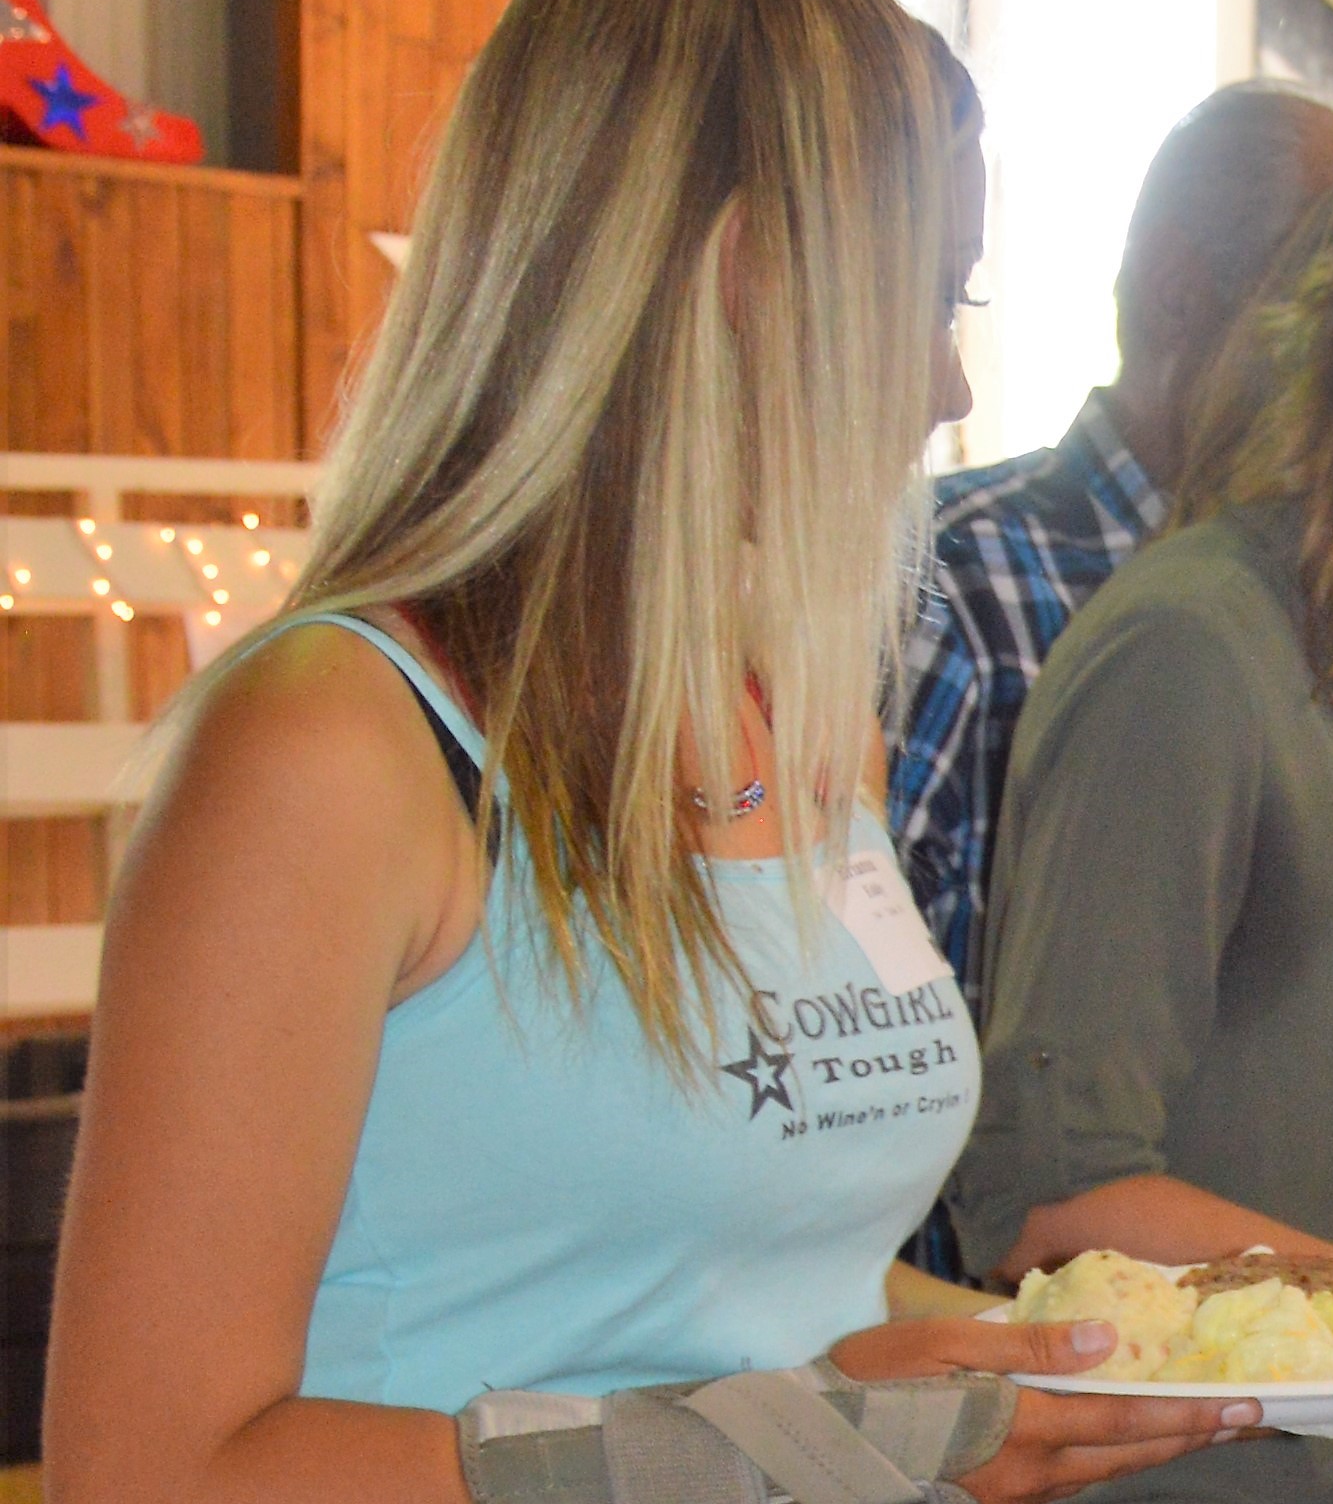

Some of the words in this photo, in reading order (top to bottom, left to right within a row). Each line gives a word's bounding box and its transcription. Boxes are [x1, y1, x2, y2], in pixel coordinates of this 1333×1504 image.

[752, 982, 954, 1043] COWGIRL
[812, 1039, 957, 1084] Tough
[781, 1120, 807, 1140] No
[892, 1102, 910, 1117] or
